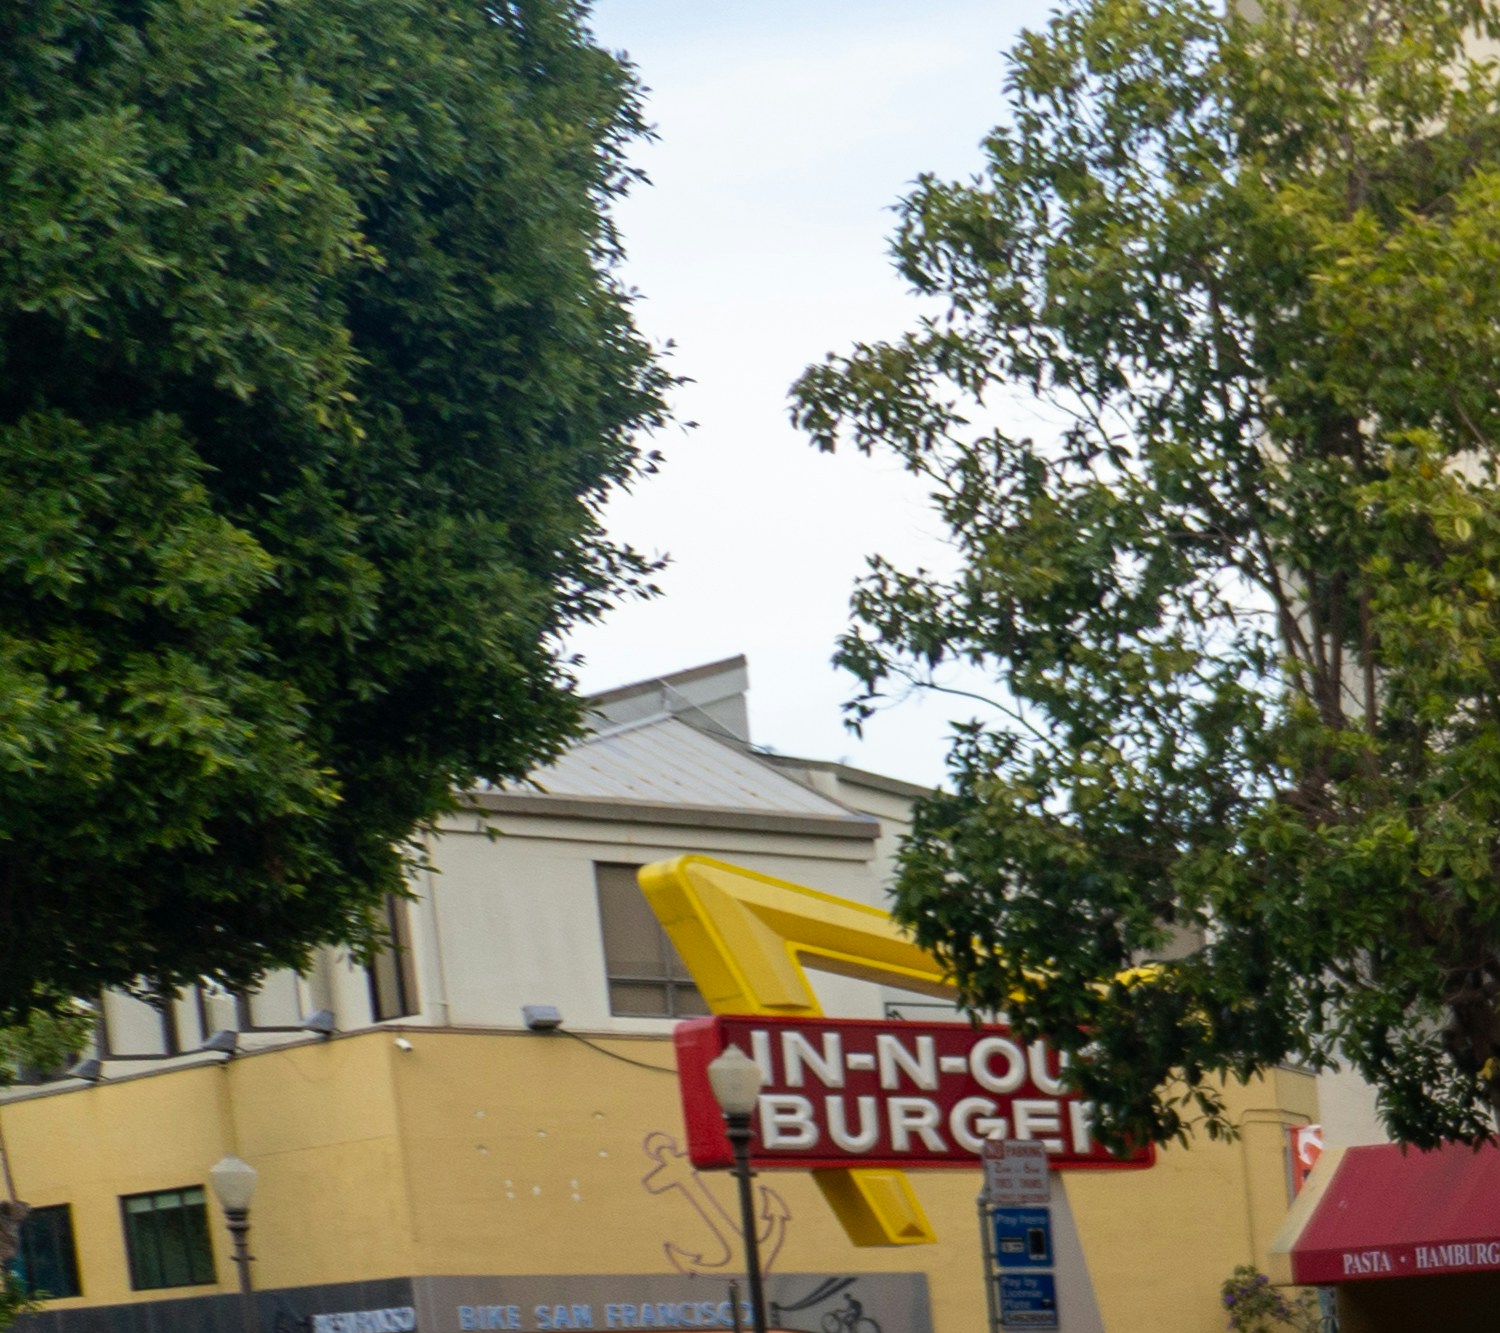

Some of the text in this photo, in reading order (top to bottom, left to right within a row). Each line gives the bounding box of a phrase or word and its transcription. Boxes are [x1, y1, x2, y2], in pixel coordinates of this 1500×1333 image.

[750, 1029, 1070, 1096] IN-N-OU
[1342, 1249, 1392, 1275] PASTA
[457, 1303, 520, 1333] BIKE
[535, 1303, 592, 1330] SAN
